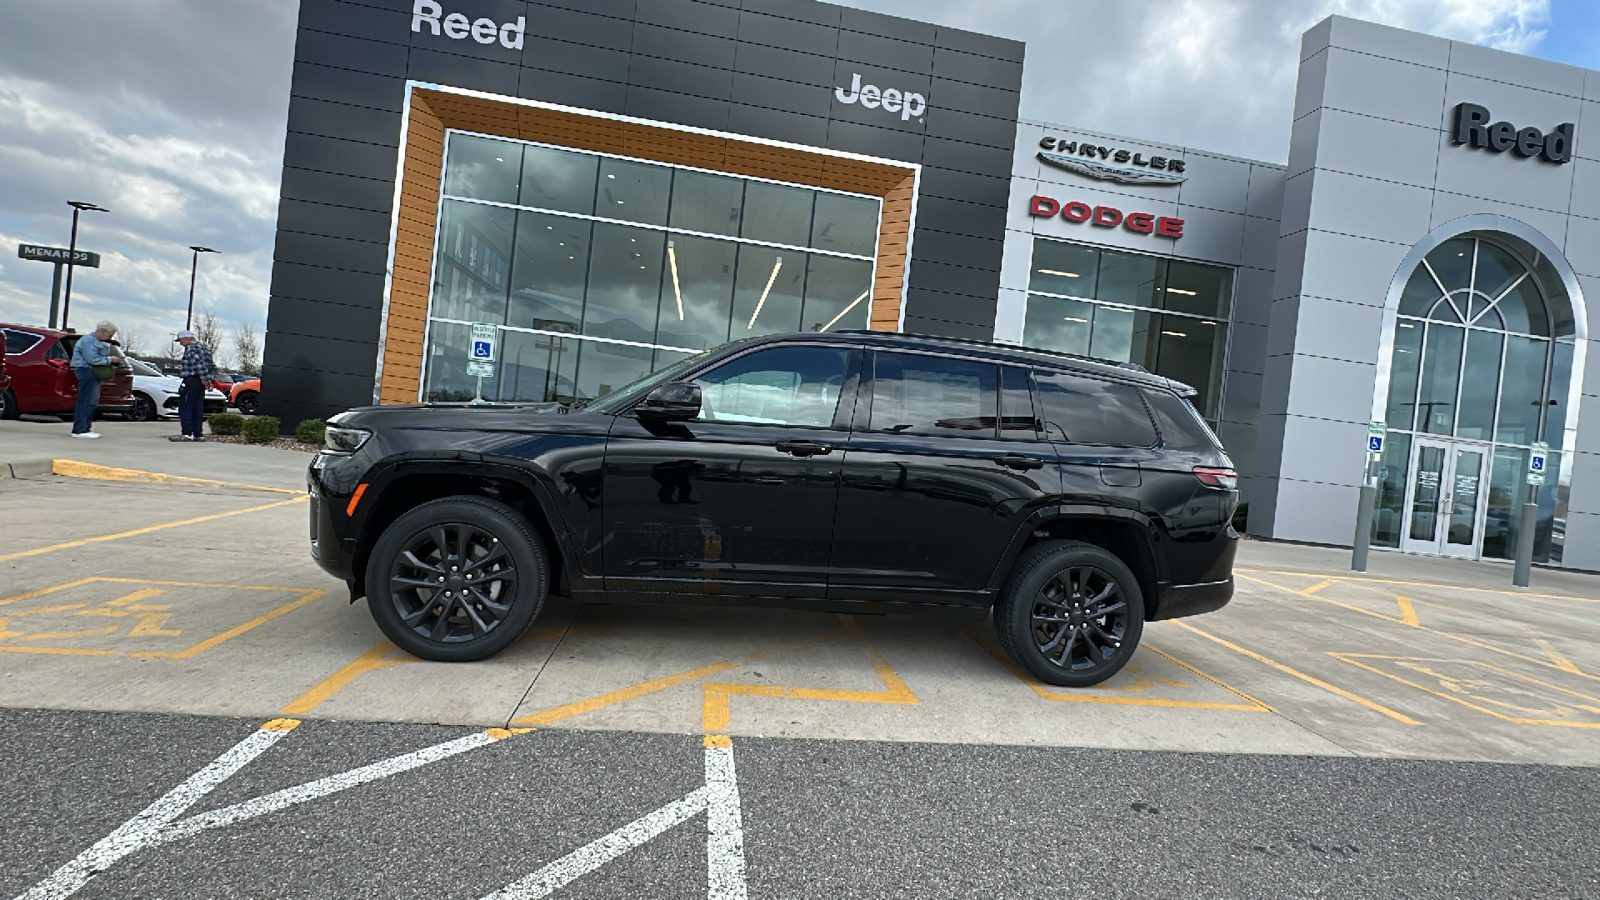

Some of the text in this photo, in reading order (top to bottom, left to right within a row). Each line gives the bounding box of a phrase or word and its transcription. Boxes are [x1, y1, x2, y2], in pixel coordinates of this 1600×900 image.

[411, 0, 525, 50] Reed
[835, 72, 926, 121] Jeep
[1039, 136, 1186, 172] CHRYSLER
[1453, 101, 1575, 164] Reed
[1029, 194, 1185, 239] DODGE
